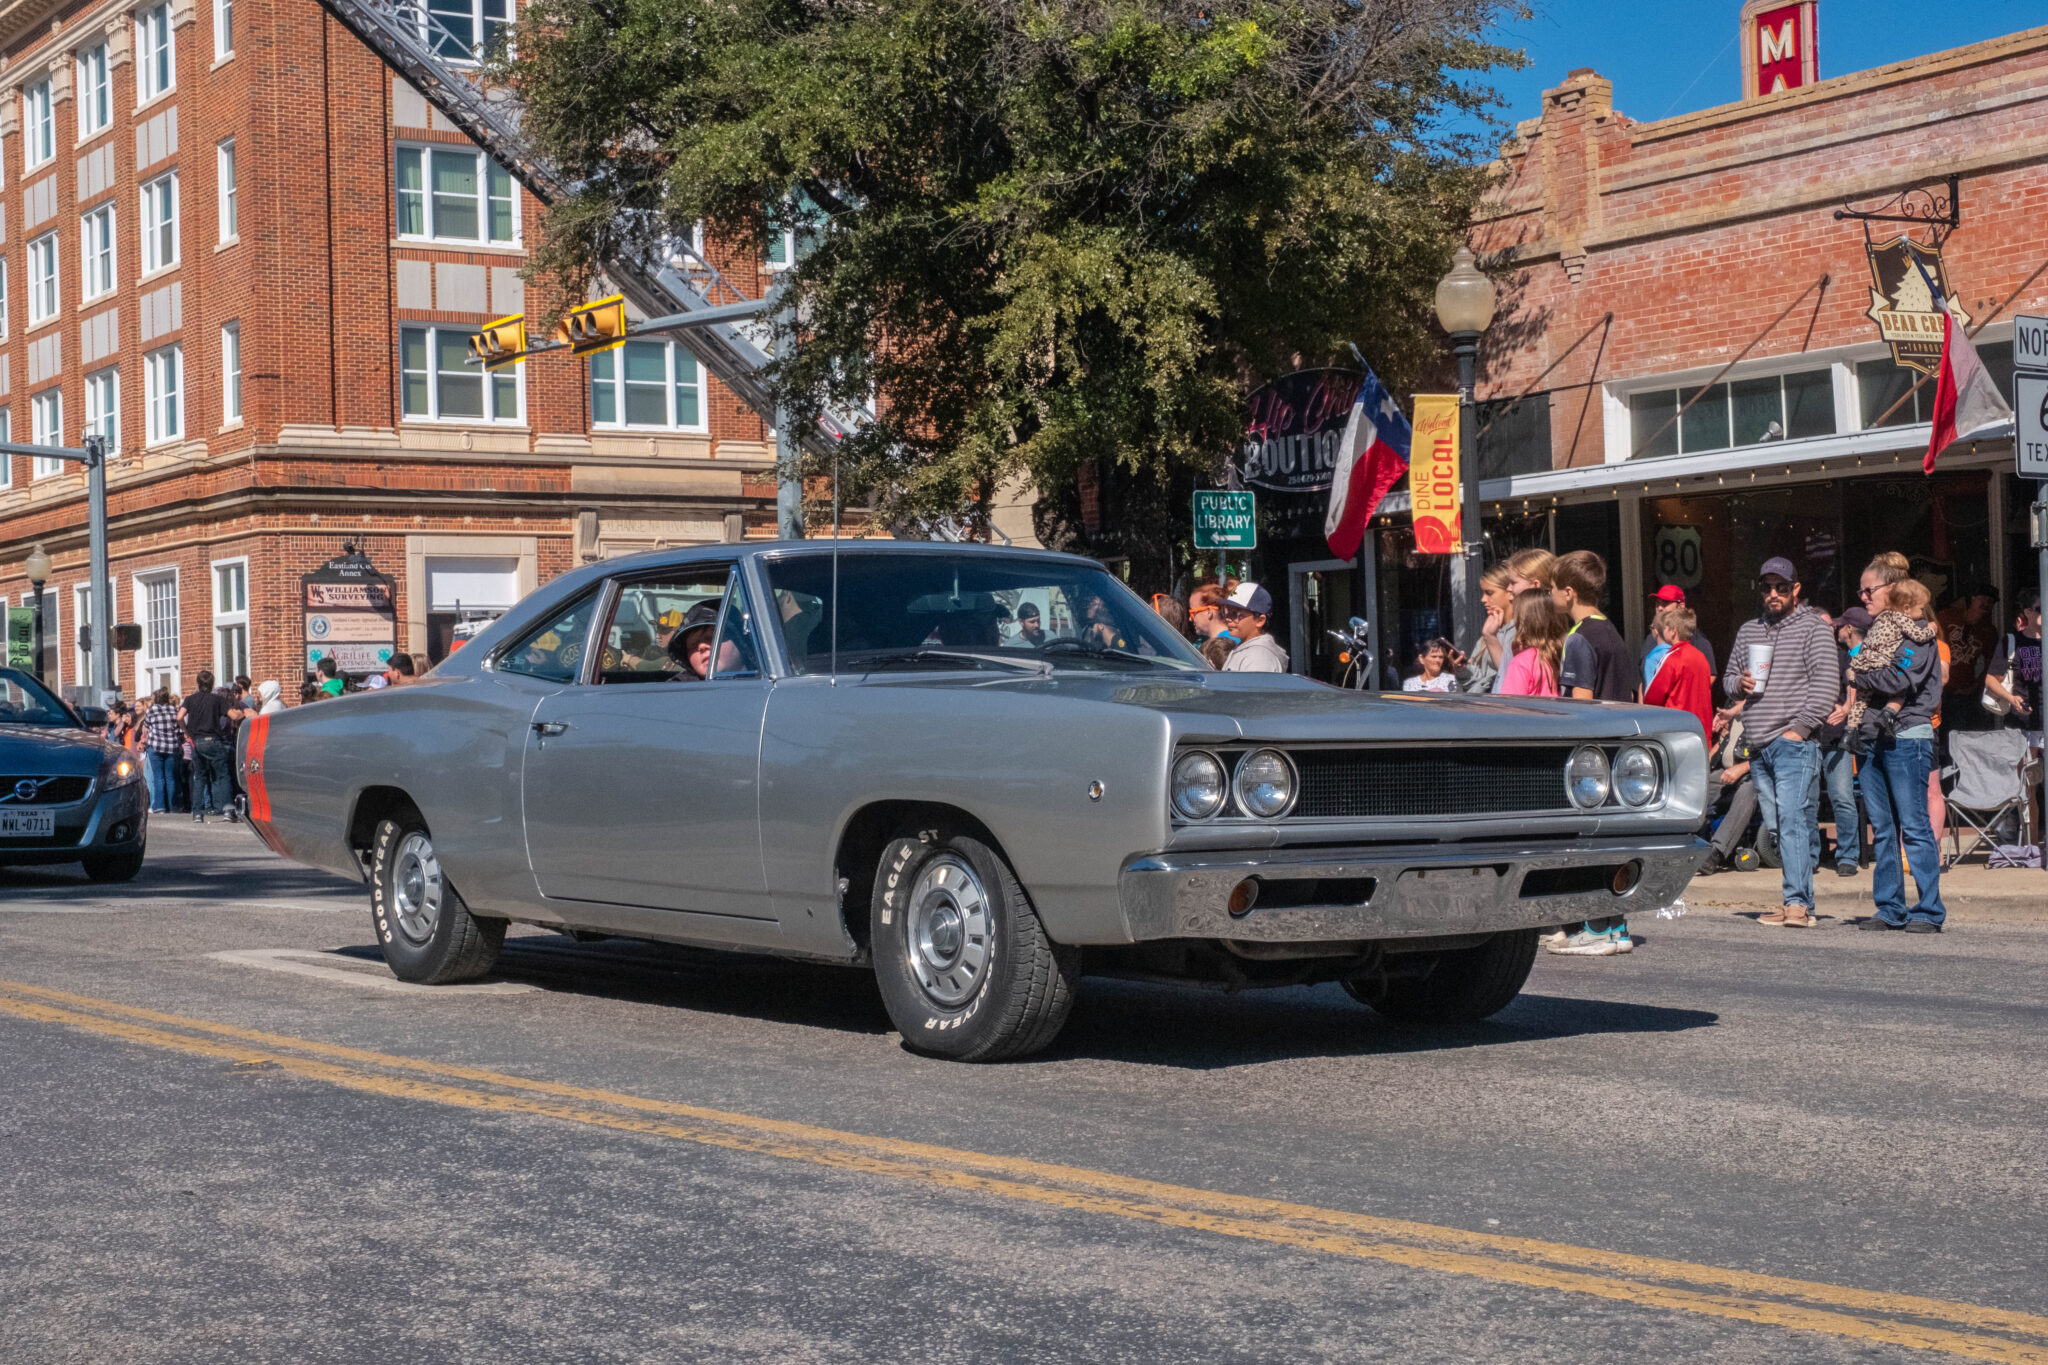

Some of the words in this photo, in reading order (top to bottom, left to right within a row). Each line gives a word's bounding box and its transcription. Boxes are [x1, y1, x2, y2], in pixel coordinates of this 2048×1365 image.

[1882, 313, 1918, 332] BEAR
[1920, 315, 1944, 333] CRE
[1907, 342, 1944, 353] TAPHOUS
[1243, 428, 1347, 482] BOUTIQ
[1432, 433, 1454, 511] LOCAL
[1201, 496, 1247, 510] PUBLIC
[1415, 472, 1431, 510] DINE
[1198, 514, 1251, 529] LIBRARY
[329, 561, 359, 569] Eastland
[1660, 539, 1699, 577] 80
[339, 569, 361, 577] Annex
[329, 593, 385, 601] SURVEYING
[374, 822, 394, 944] GOODYEAR
[881, 844, 913, 926] EAGLE
[918, 828, 940, 844] ST
[924, 917, 996, 1031] GOODYEAR
